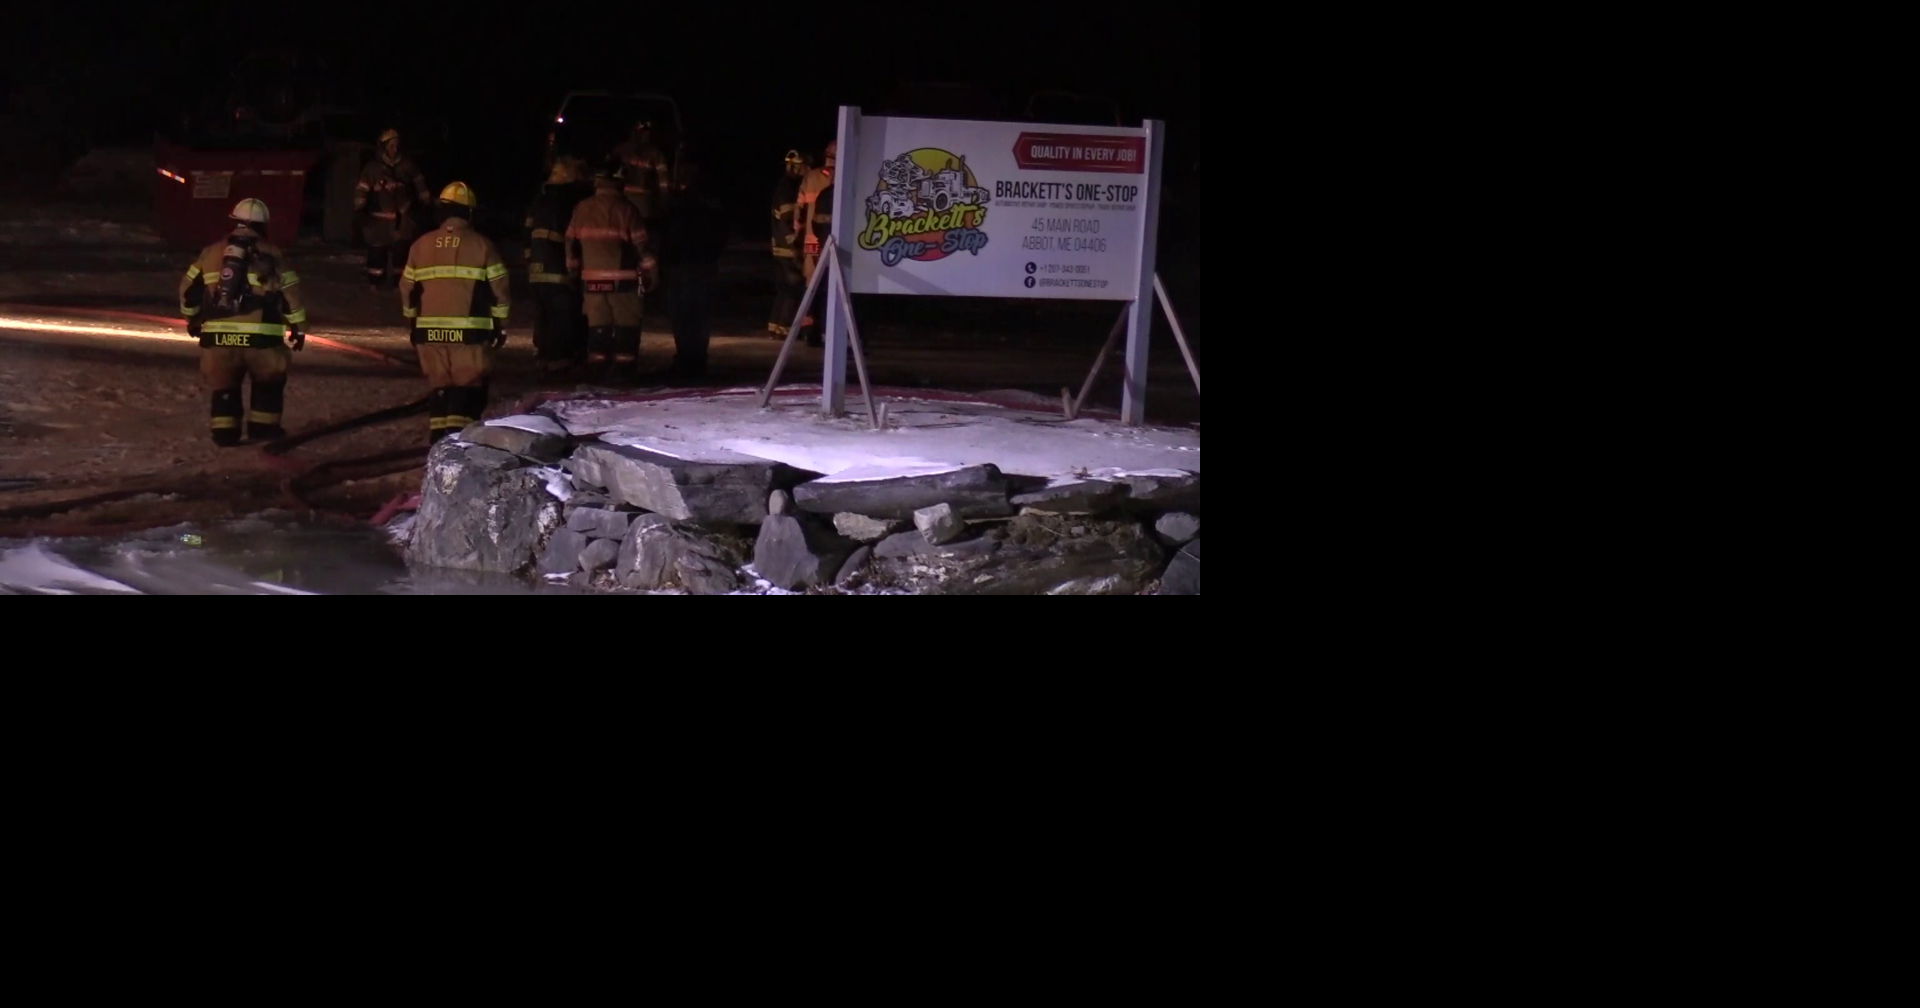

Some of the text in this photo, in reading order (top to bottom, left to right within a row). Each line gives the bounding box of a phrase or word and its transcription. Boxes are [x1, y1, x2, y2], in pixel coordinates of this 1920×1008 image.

[1030, 145, 1137, 162] QUALITY IN EVERY JOB!
[995, 180, 1138, 202] BRACKETT'S ONE-STOP
[1031, 217, 1100, 233] 45 MAIN ROAD
[435, 236, 460, 248] SFD
[1057, 236, 1072, 251] ME
[1074, 238, 1107, 253] 04406
[215, 333, 250, 346] LABREE
[427, 329, 463, 342] BOUTON
